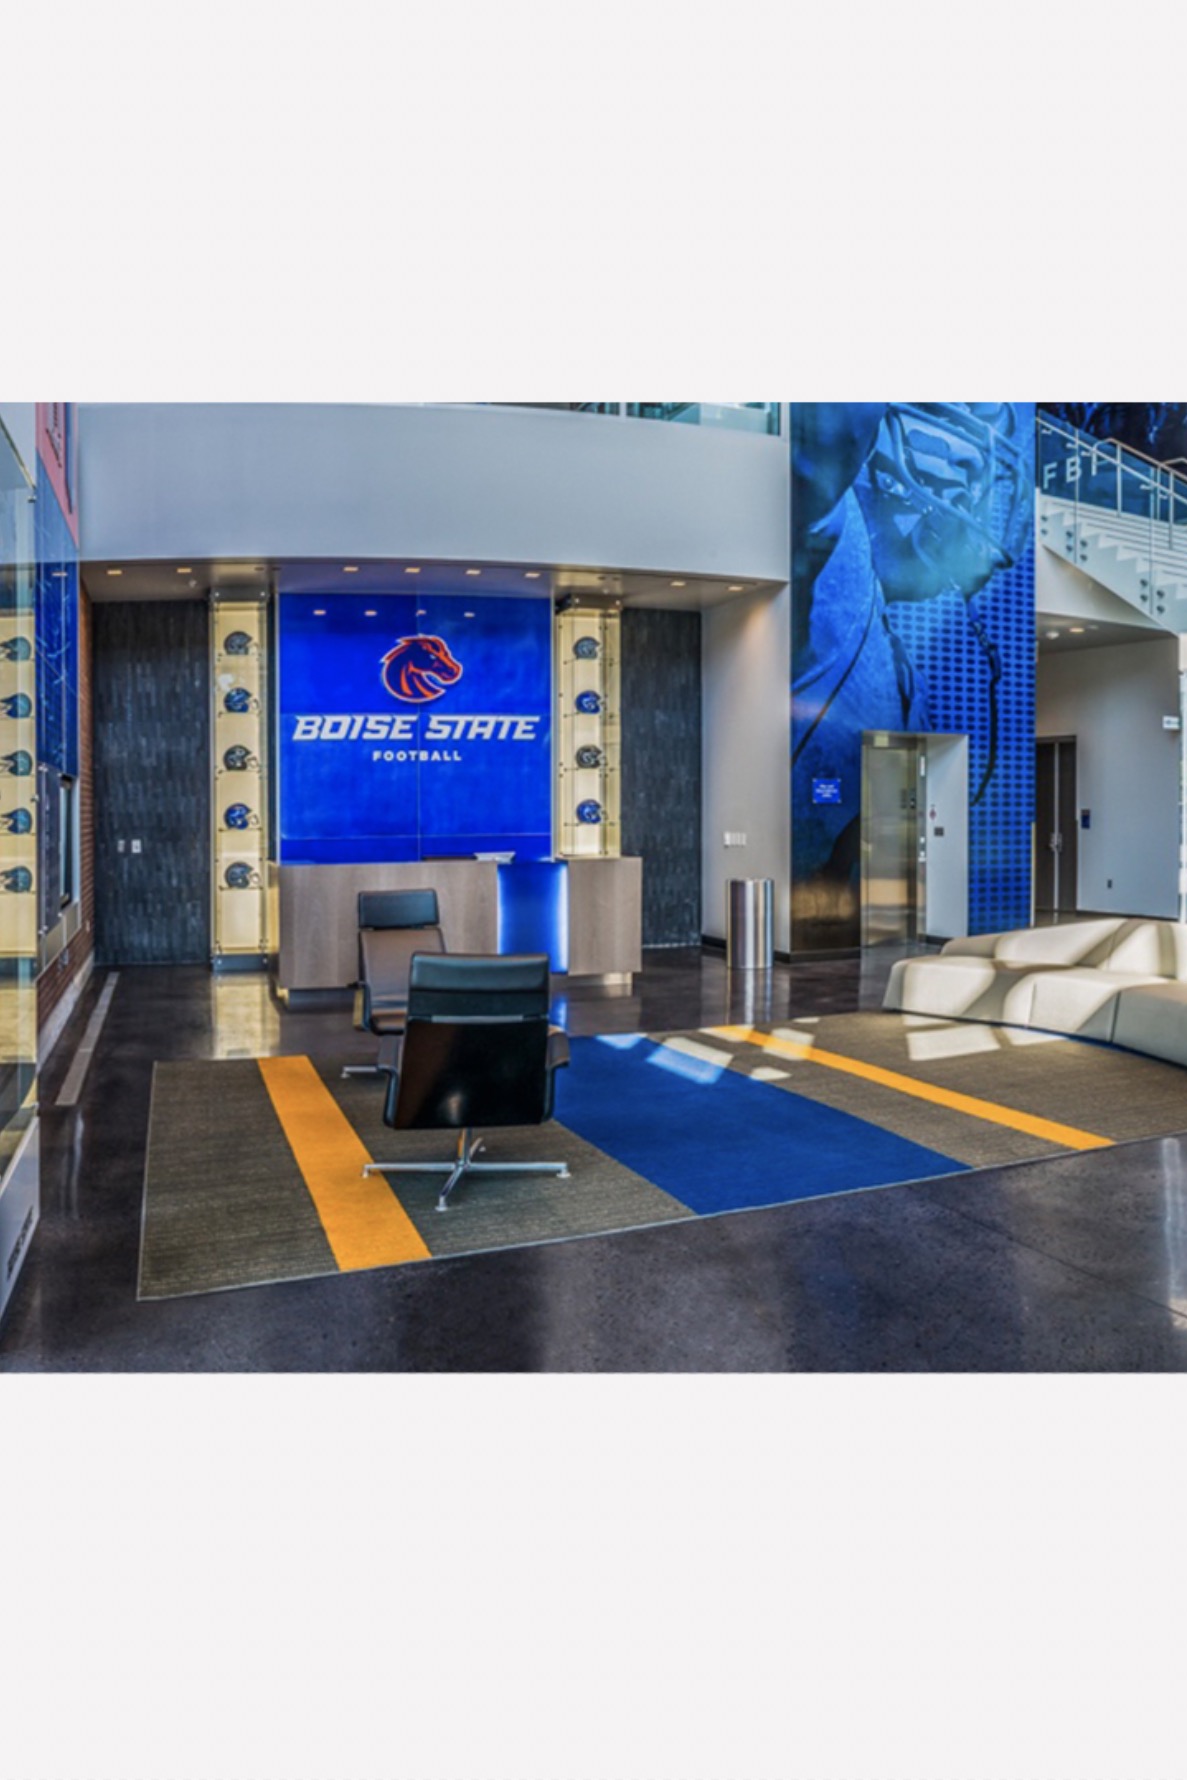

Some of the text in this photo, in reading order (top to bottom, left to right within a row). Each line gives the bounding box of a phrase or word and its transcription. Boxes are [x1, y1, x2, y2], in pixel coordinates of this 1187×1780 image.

[293, 715, 540, 741] BOISE STATE
[372, 750, 462, 762] FOOTBALL
